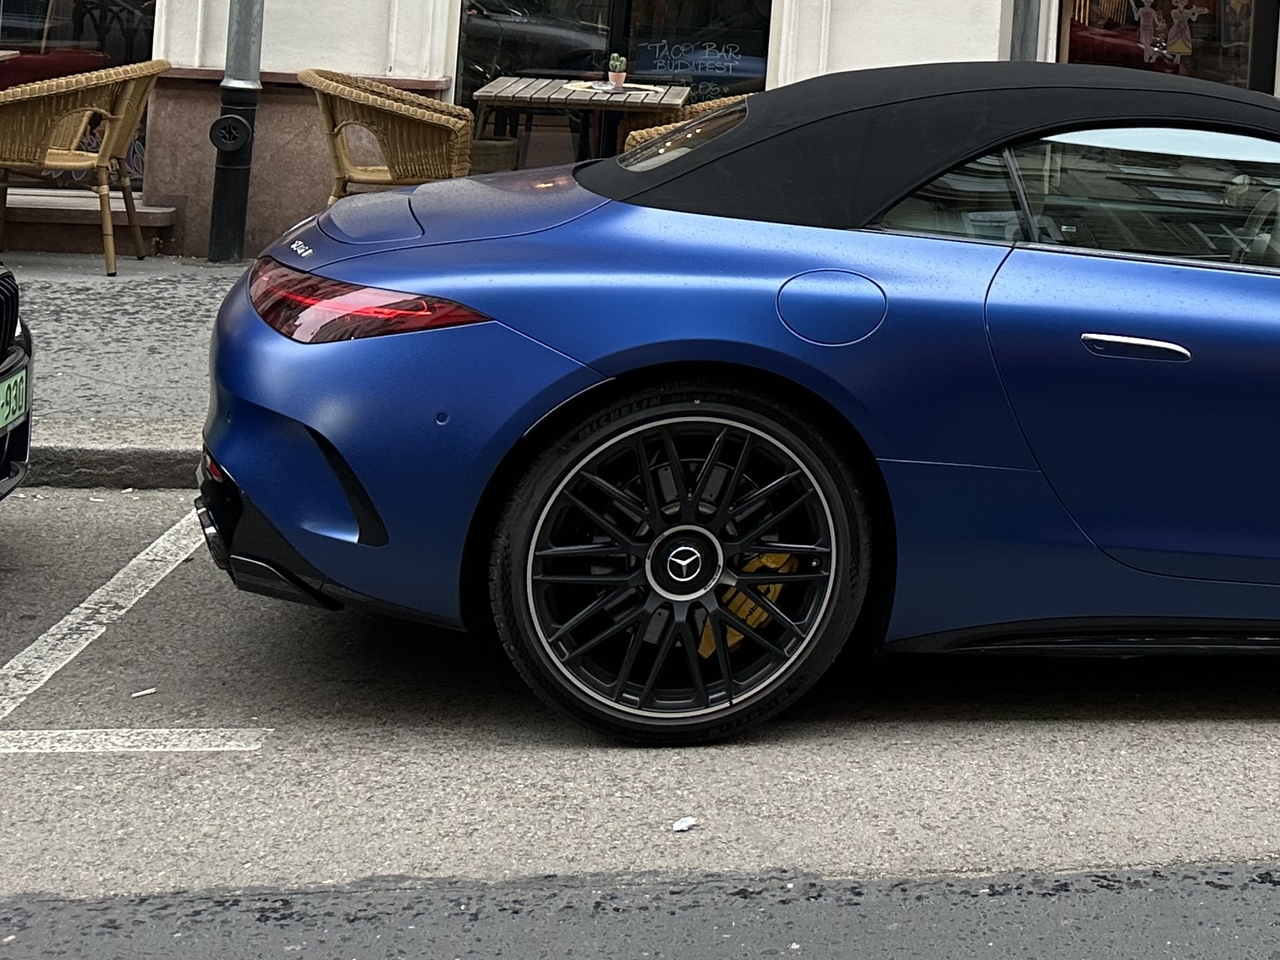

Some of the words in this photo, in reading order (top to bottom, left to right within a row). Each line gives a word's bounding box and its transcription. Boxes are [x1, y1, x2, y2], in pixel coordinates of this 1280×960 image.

[647, 40, 695, 60] TACO
[702, 42, 742, 60] BAR
[652, 60, 739, 75] BUDAPEST
